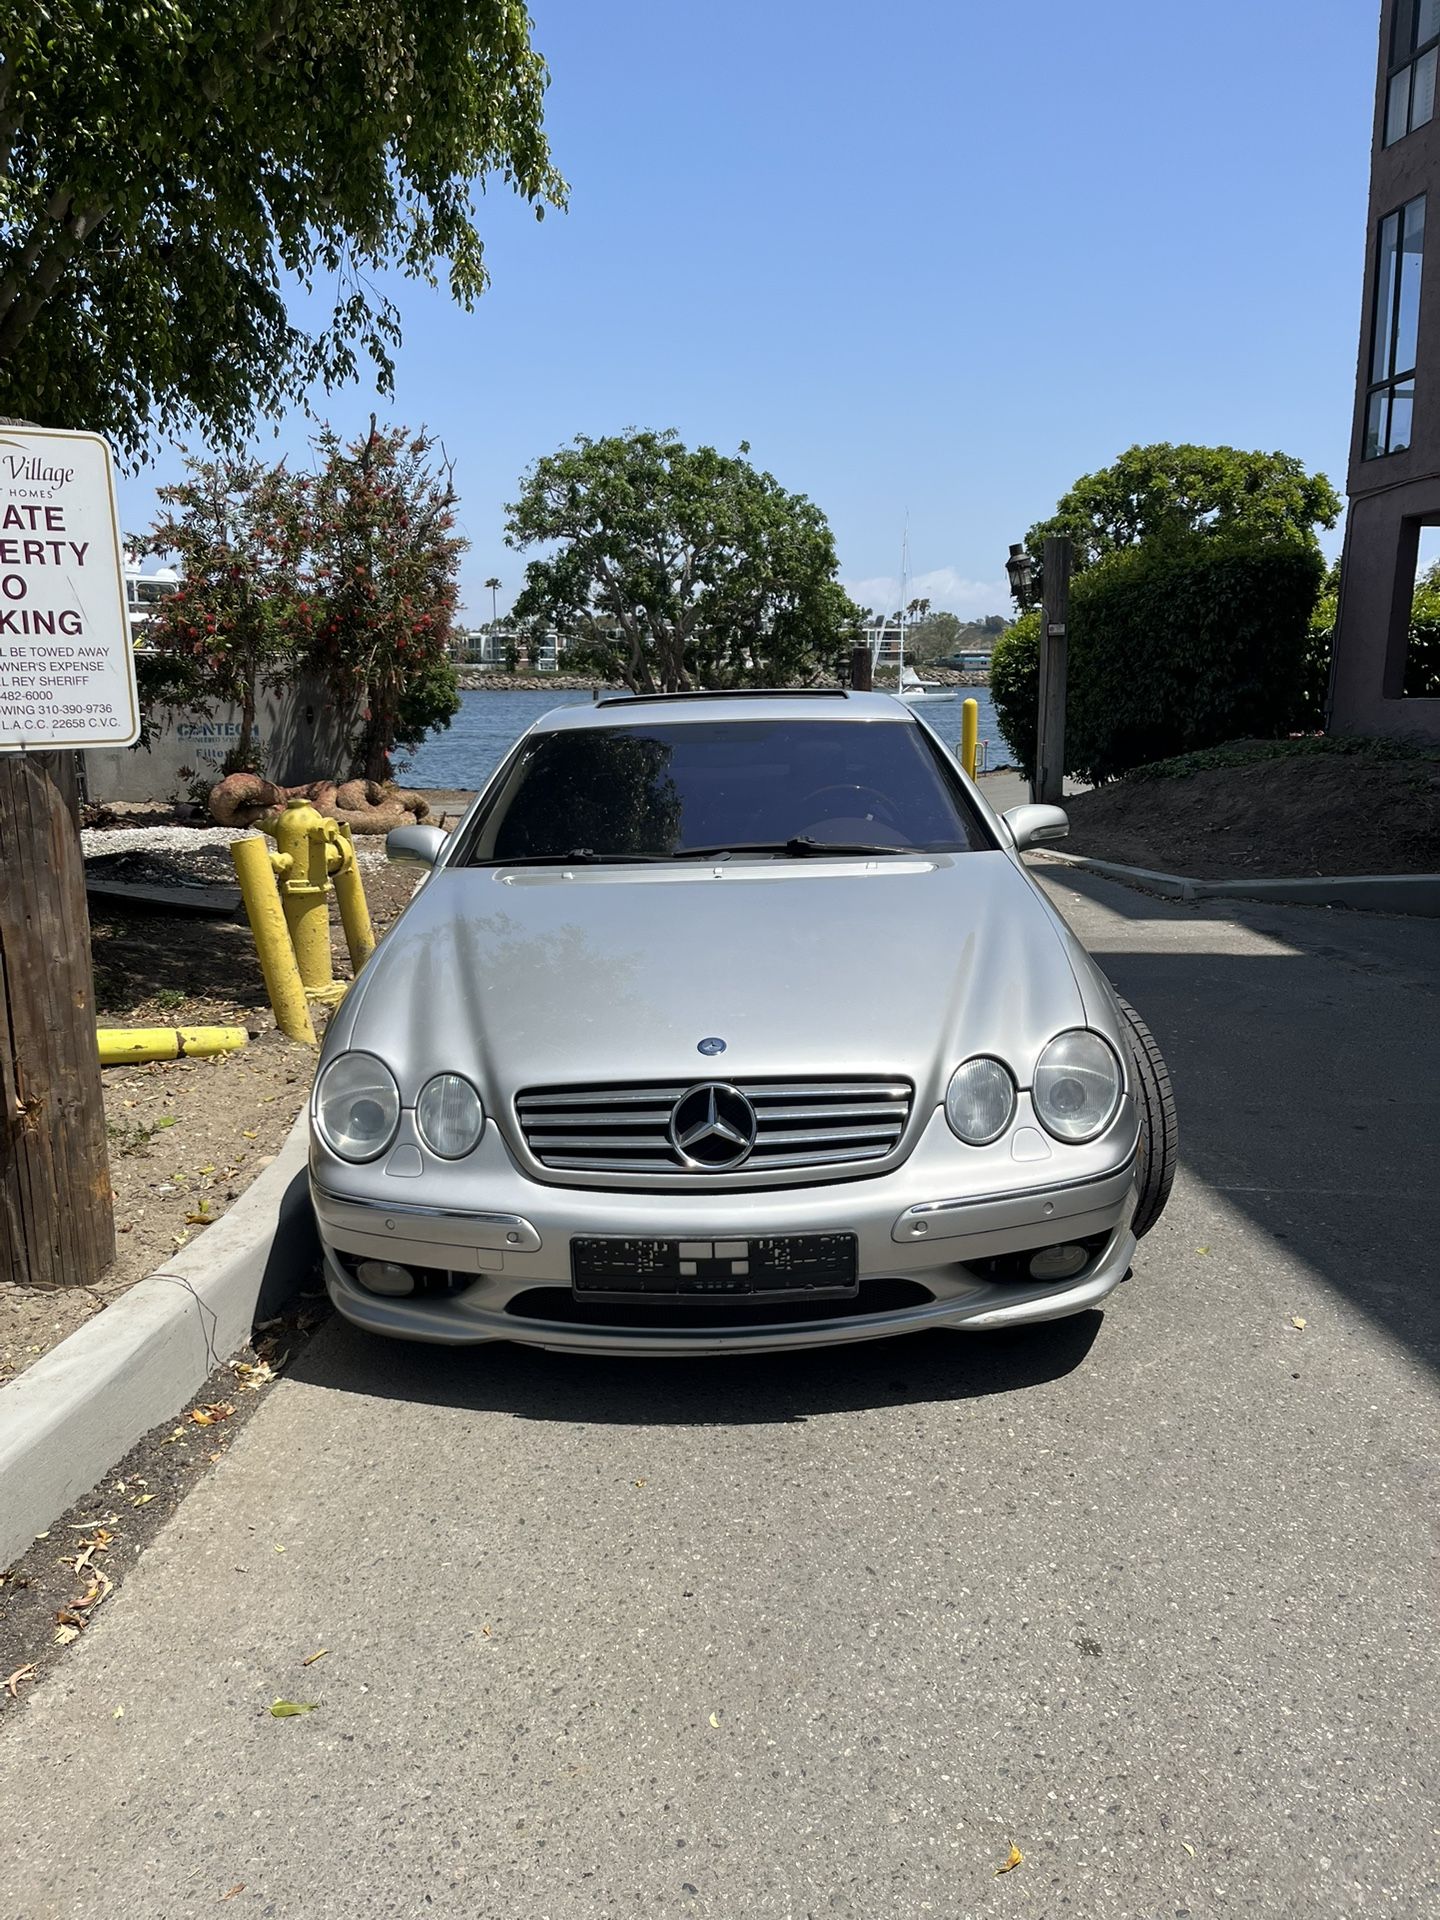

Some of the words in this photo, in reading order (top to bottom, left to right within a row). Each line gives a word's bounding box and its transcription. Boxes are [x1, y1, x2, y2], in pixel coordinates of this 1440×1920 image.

[2, 455, 75, 490] Village
[9, 489, 53, 499] HOMES
[2, 504, 66, 531] ATE
[0, 539, 89, 566] ERTY
[2, 574, 27, 600] O
[0, 610, 83, 635] KING
[10, 647, 26, 657] BE
[30, 647, 75, 657] TOWED
[77, 647, 110, 657] AWAY
[50, 661, 104, 671] EXPENSE
[12, 677, 35, 686] REY
[39, 676, 89, 686] SHERIFF
[0, 705, 35, 715] WING
[39, 704, 113, 715] 310-390-9736
[2, 720, 49, 730] L.A.C.C.
[52, 718, 86, 729] 22658
[88, 717, 121, 728] C.V.C.
